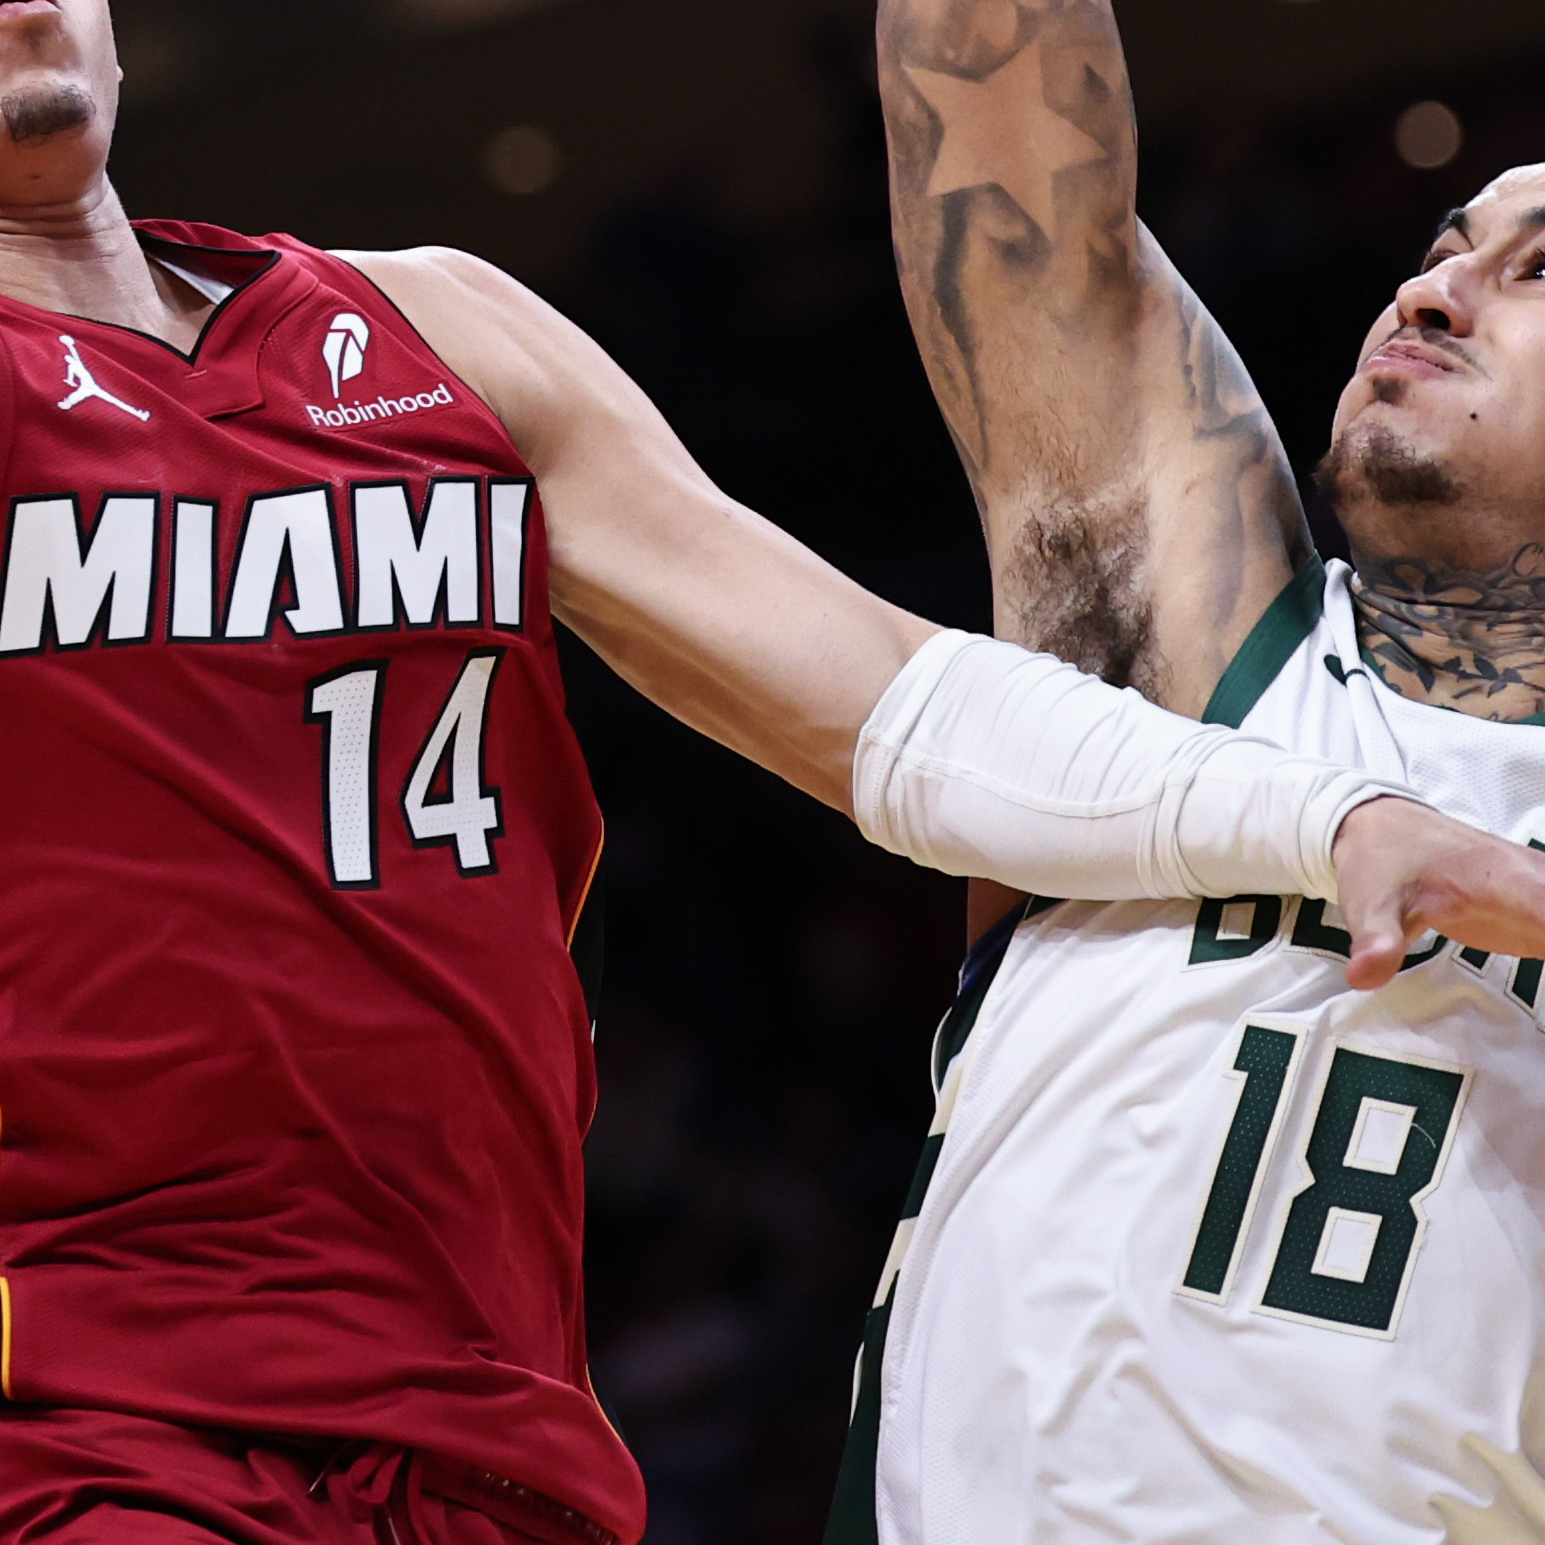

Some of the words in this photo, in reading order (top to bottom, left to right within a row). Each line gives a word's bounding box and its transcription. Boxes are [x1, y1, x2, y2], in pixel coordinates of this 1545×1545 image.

[305, 383, 454, 429] Robinhood
[305, 651, 502, 888] 14
[1175, 1017, 1473, 1341] 18
